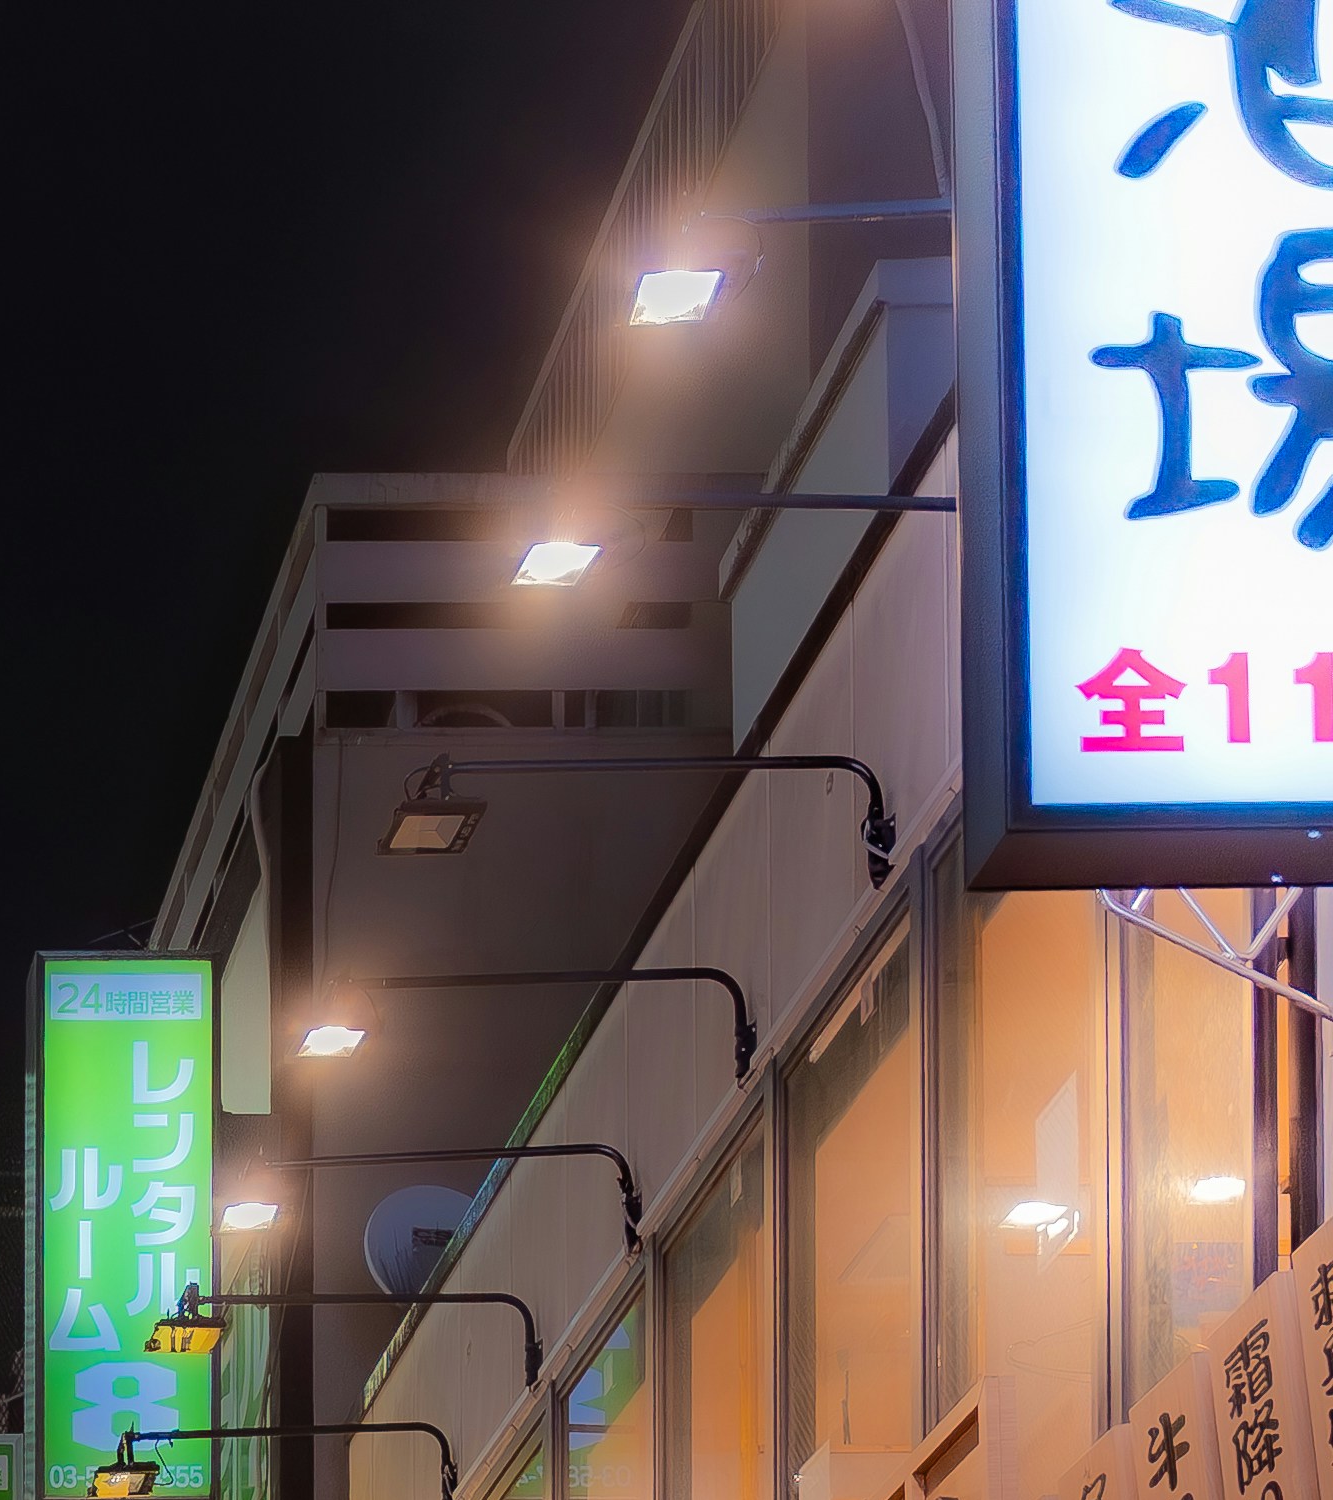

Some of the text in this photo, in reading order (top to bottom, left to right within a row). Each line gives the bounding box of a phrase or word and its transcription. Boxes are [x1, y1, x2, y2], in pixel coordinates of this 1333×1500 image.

[56, 984, 196, 1017] 24時間営業
[49, 1147, 123, 1353] ルーム
[127, 1041, 197, 1318] レンタル
[71, 1361, 181, 1454] 8
